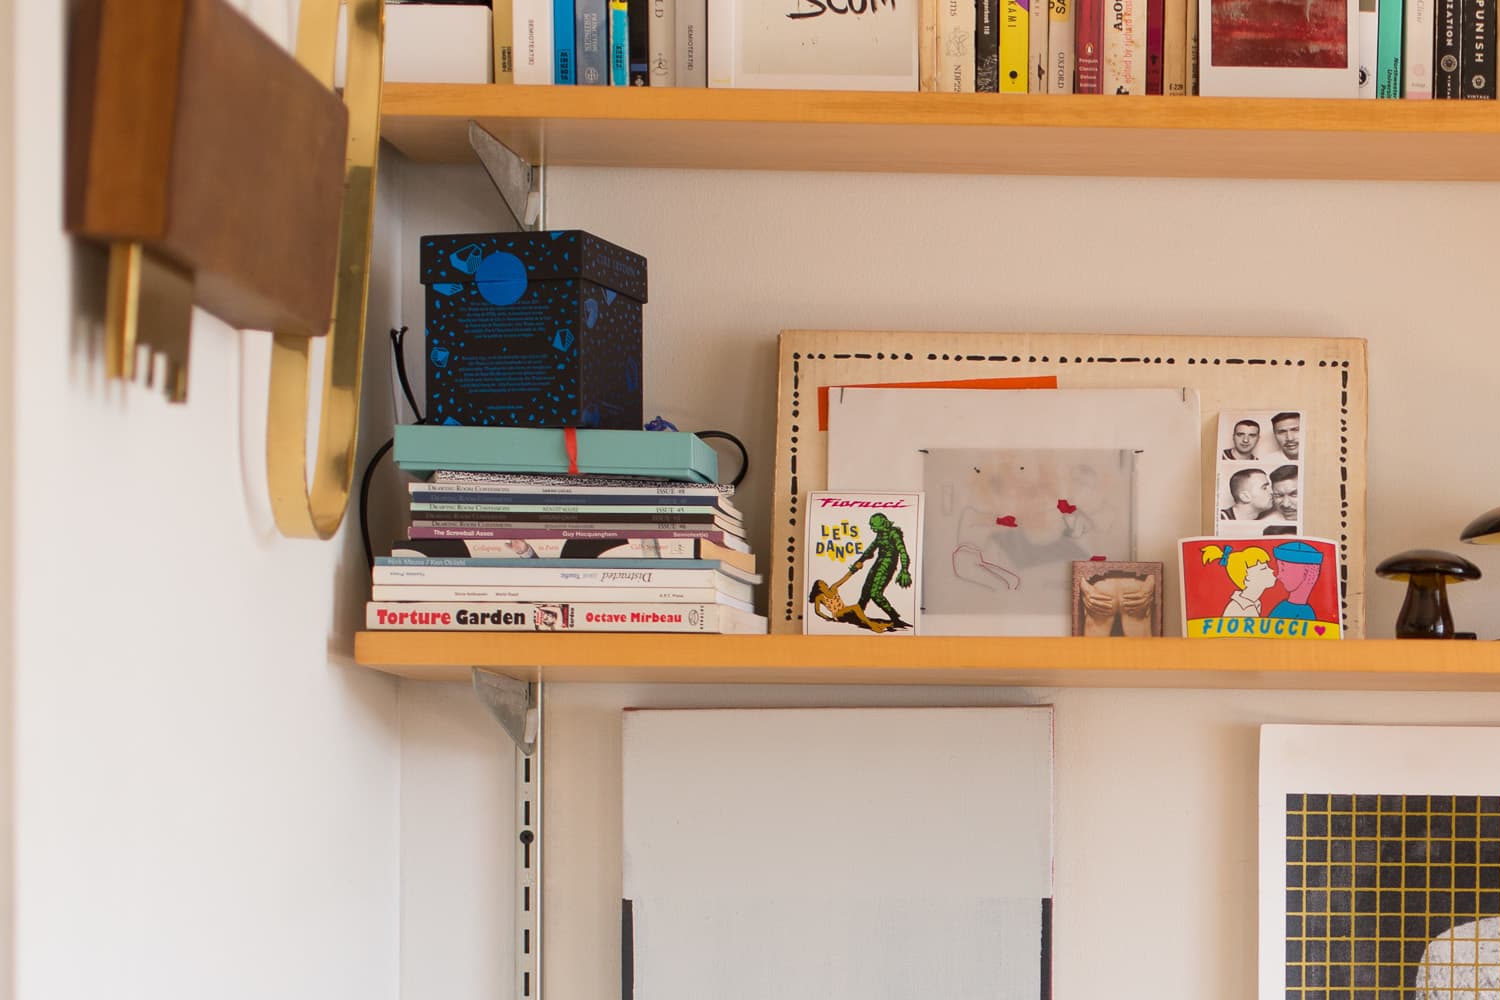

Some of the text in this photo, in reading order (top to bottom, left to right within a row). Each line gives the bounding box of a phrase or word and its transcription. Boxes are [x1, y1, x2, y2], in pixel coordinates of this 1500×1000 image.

[1474, 0, 1486, 63] PUNISH
[1057, 52, 1065, 89] OXFORD
[433, 529, 445, 537] The
[446, 529, 475, 538] Screwball
[562, 531, 575, 539] Guy
[821, 521, 859, 540] LETS
[815, 538, 864, 560] DANCE
[601, 572, 652, 583] Distracted
[376, 608, 526, 625] Torture Garden
[585, 611, 682, 624] Octave Mirbeau
[1201, 617, 1309, 638] FIORUCCI
